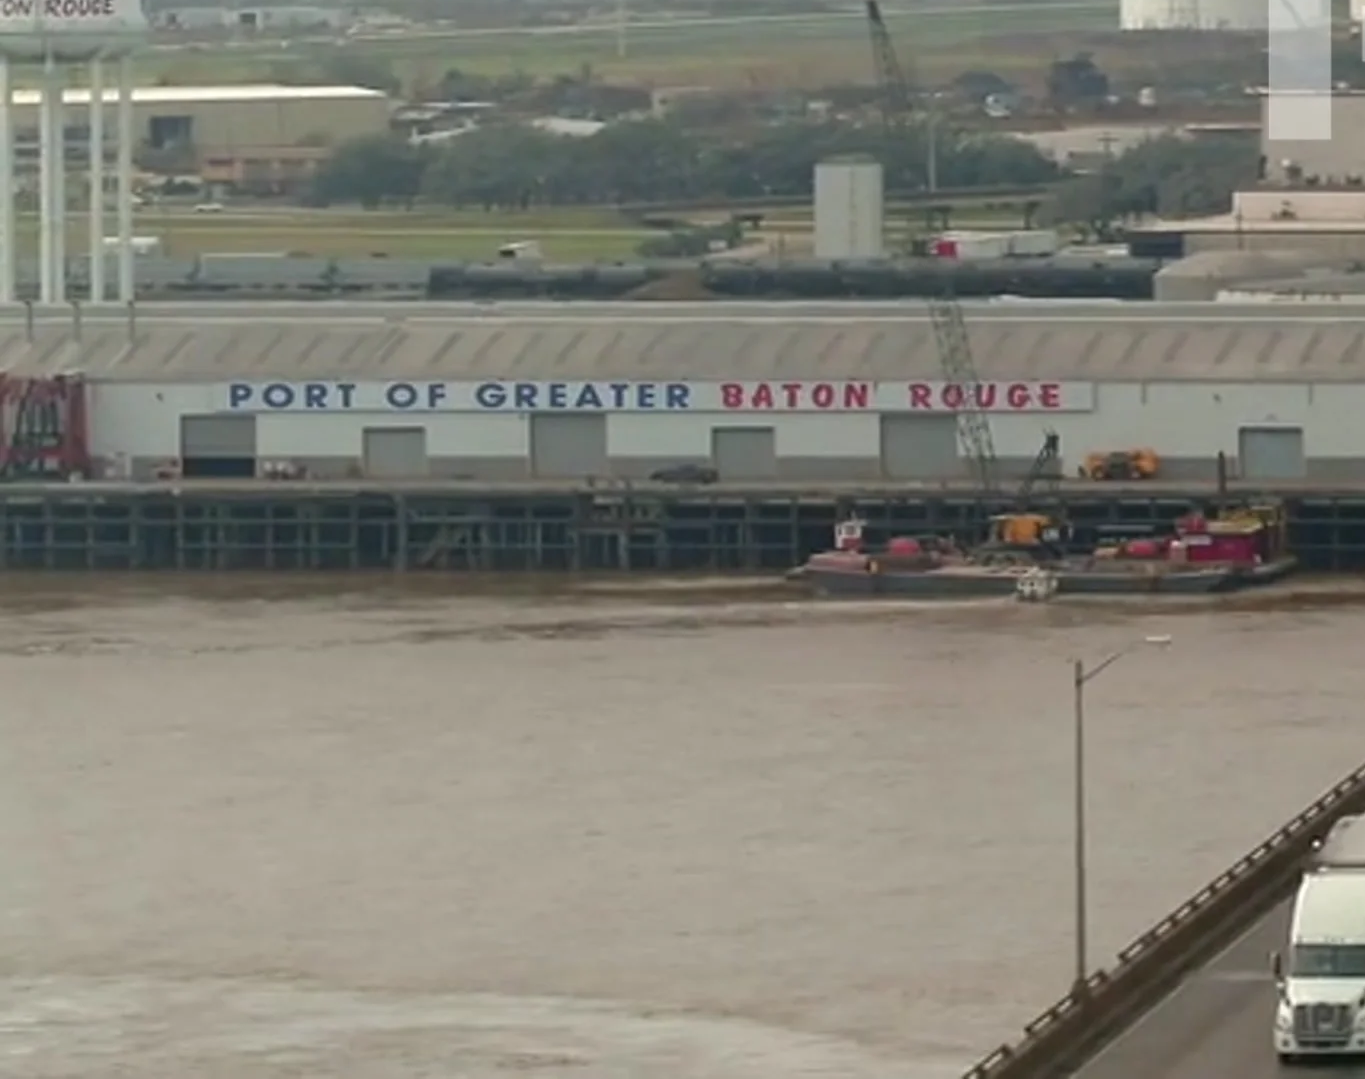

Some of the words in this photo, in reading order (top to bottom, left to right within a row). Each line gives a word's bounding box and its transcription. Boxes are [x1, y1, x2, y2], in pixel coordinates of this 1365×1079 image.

[228, 383, 356, 409] PORT
[386, 383, 447, 409] OF
[474, 383, 691, 409] GREATER
[721, 383, 869, 409] BATON
[908, 383, 1060, 409] ROUGE
